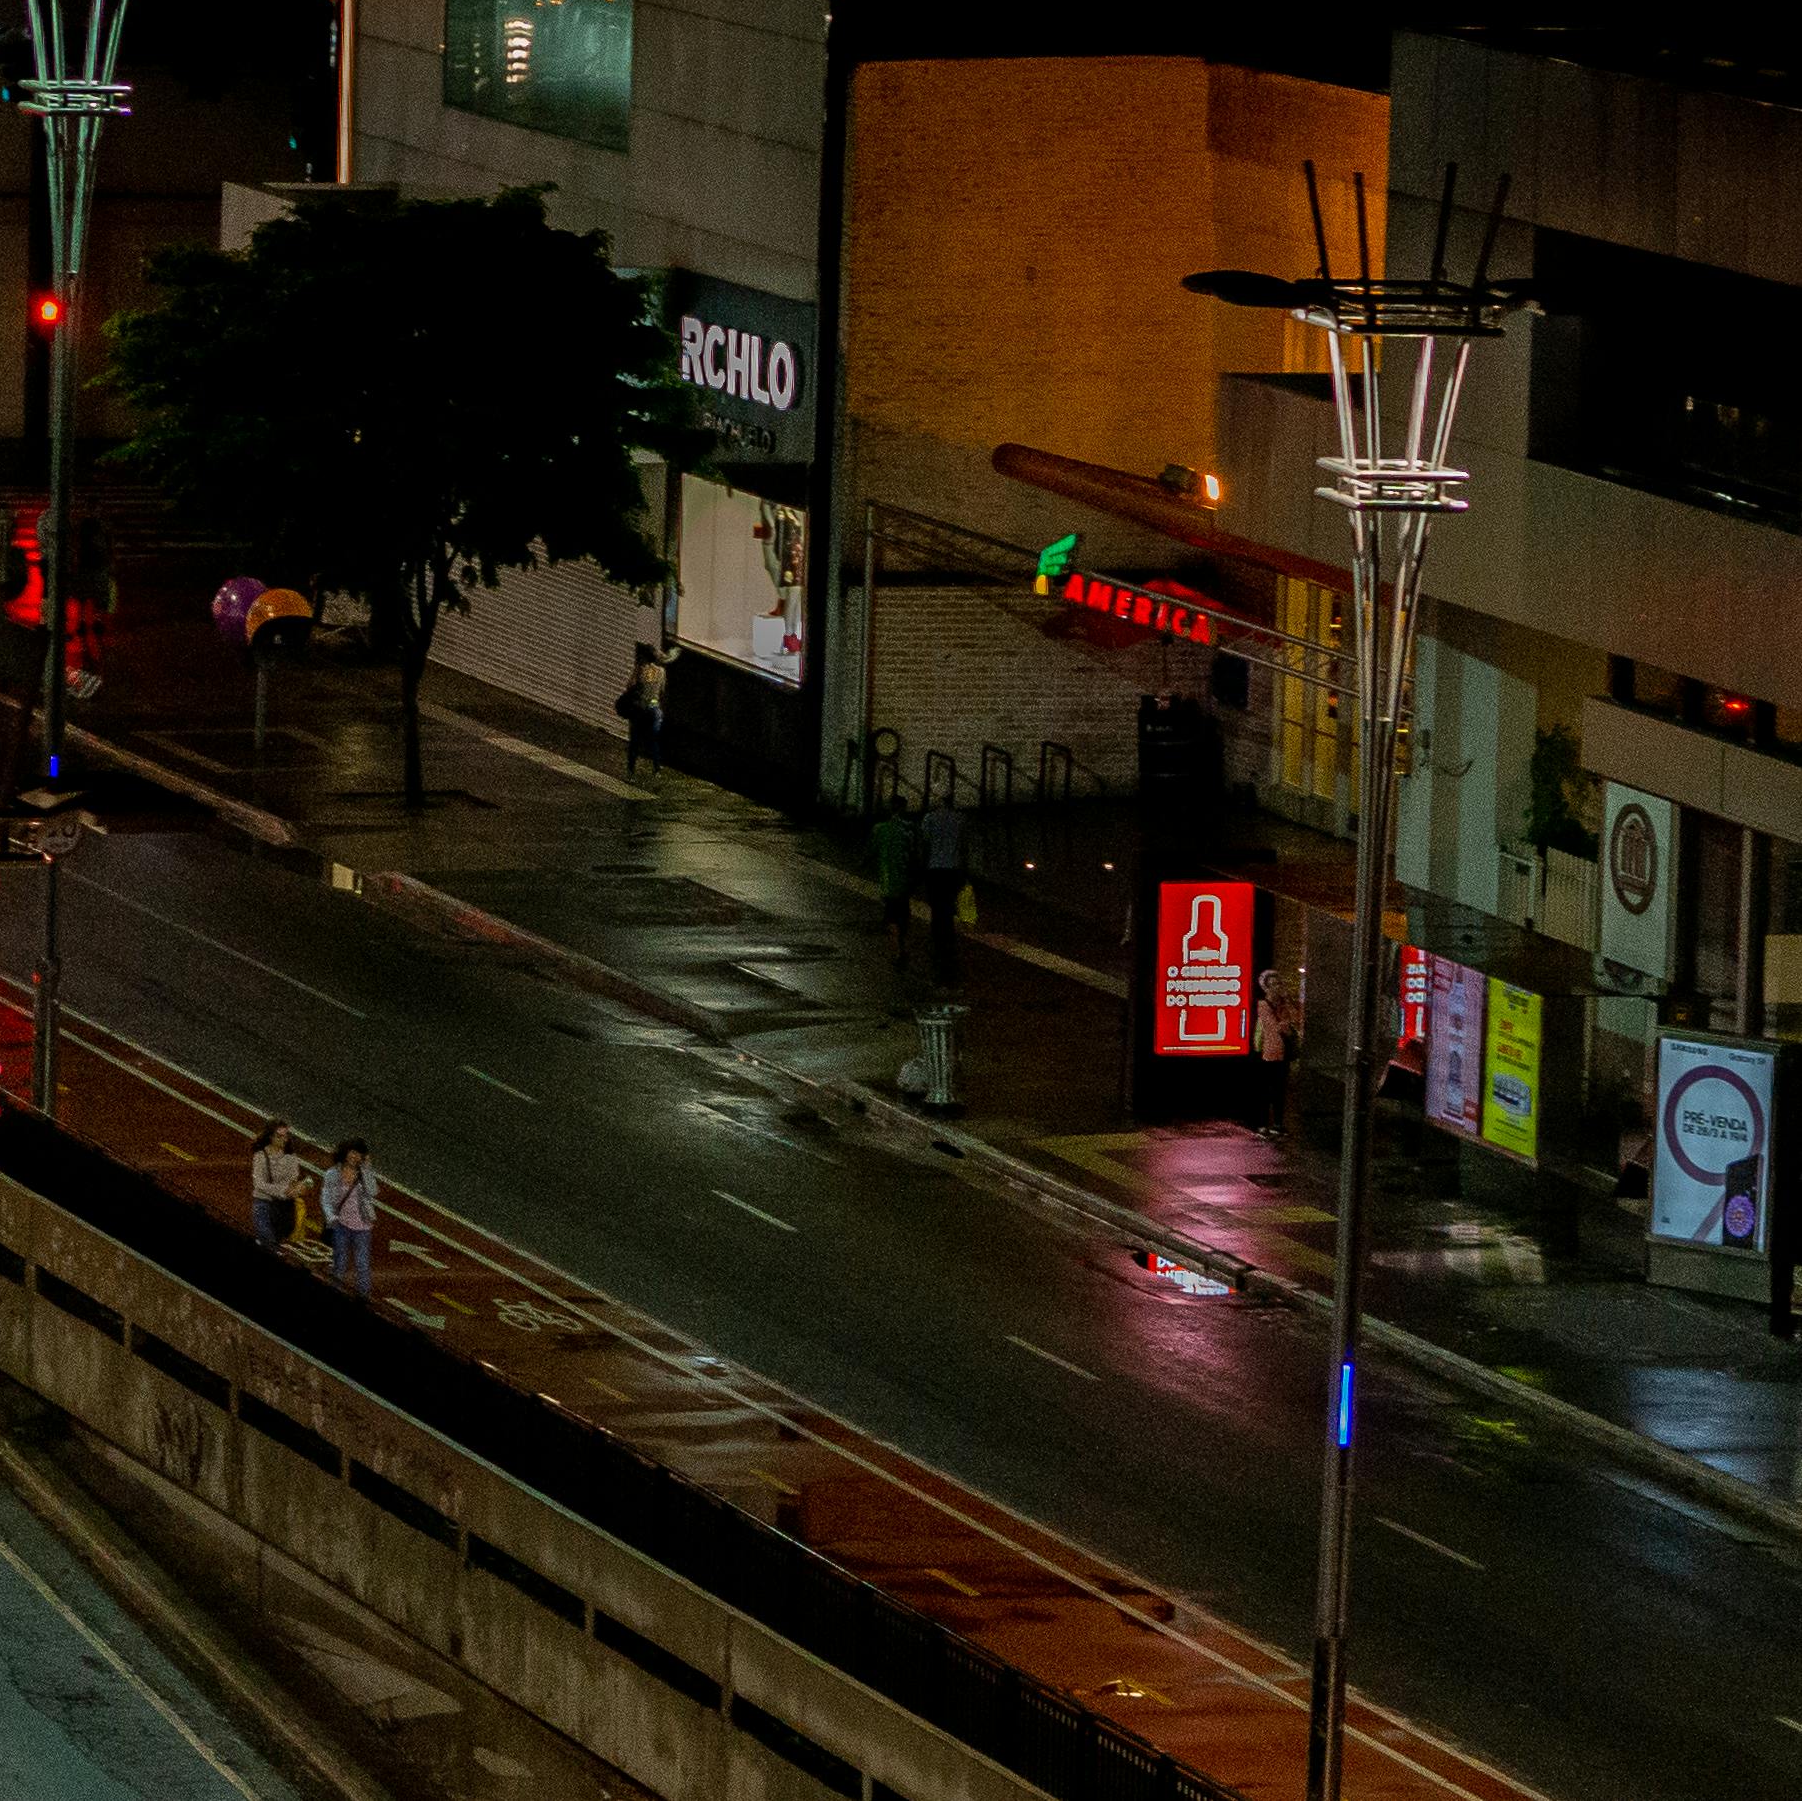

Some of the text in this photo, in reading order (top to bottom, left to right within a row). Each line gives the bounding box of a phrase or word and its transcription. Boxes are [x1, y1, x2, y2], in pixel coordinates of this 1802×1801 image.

[682, 315, 795, 411] RCHLO
[1167, 966, 1179, 978] O
[1166, 994, 1187, 1007] DO
[1683, 1109, 1749, 1132] PRÉ-VENDA
[1682, 1123, 1695, 1135] DE
[1720, 1130, 1728, 1140] A
